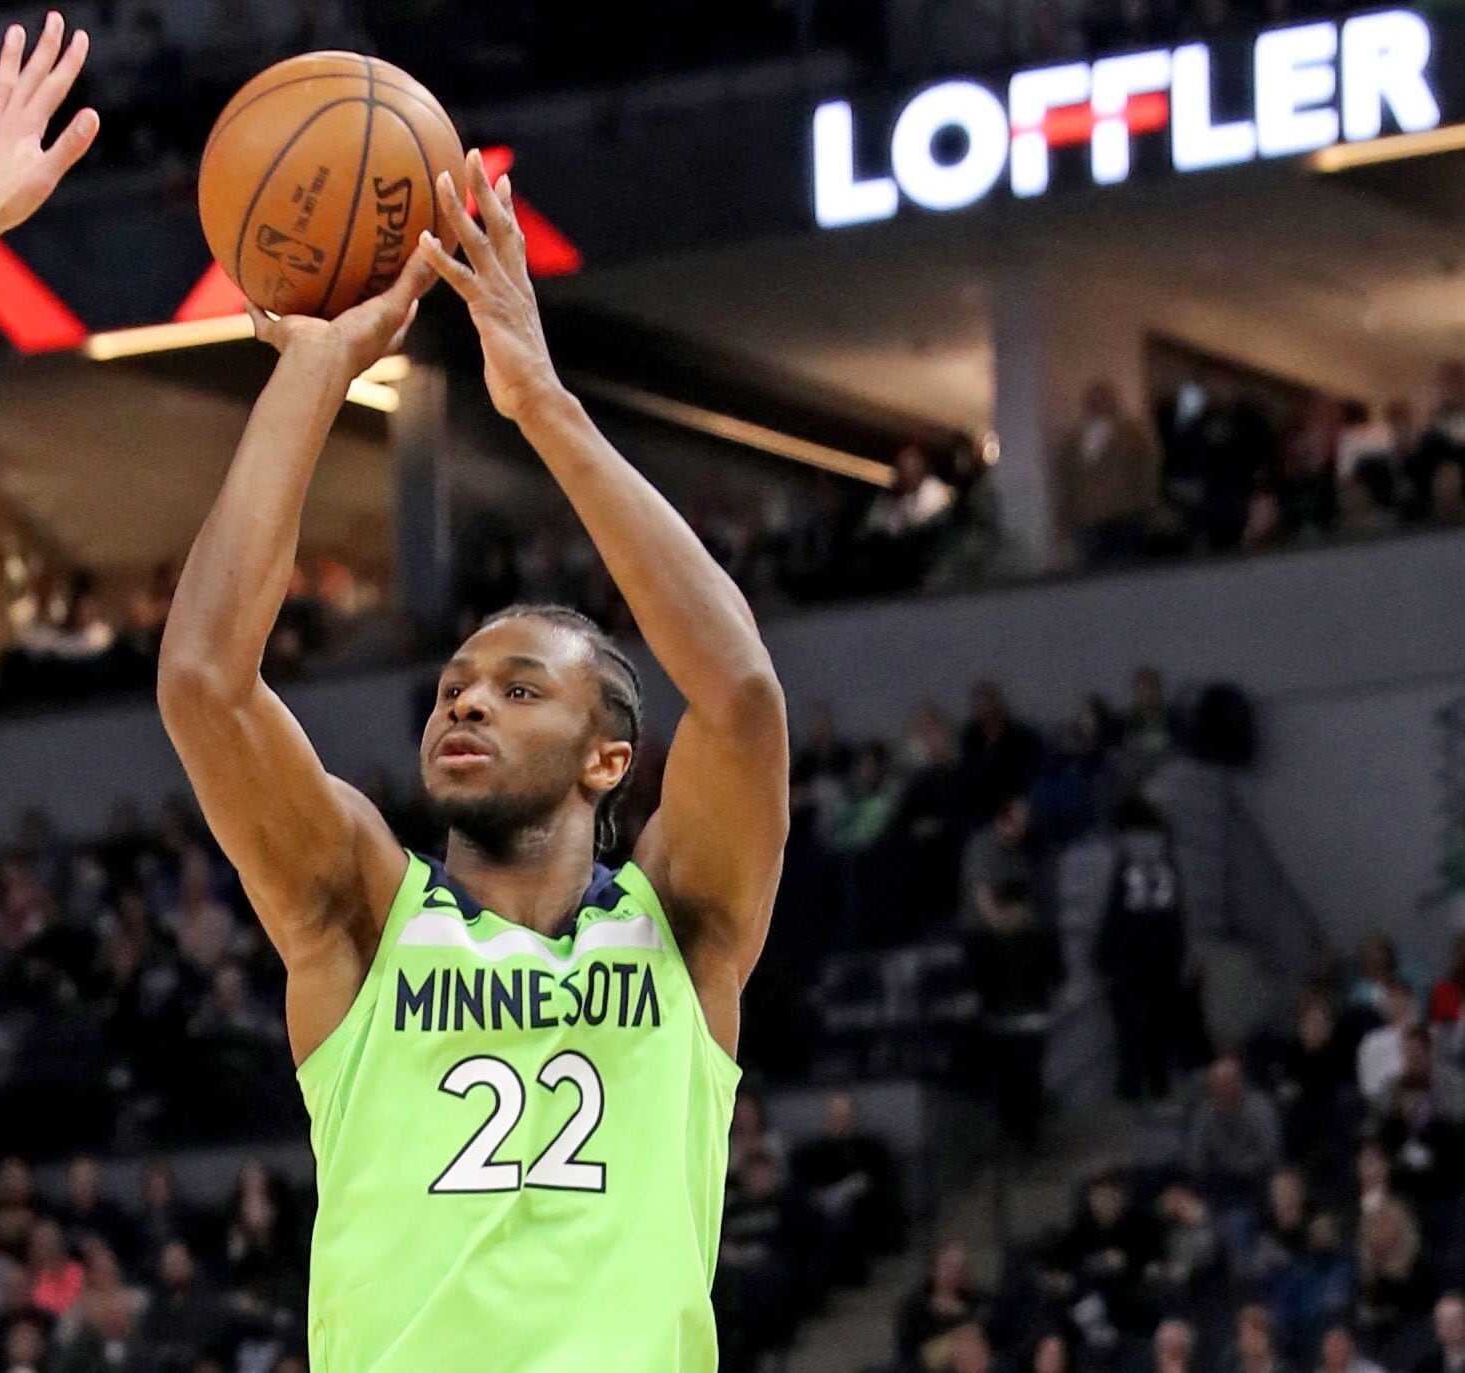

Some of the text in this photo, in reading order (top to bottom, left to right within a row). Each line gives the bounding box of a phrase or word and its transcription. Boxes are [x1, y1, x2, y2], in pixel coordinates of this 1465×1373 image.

[813, 9, 1440, 229] LOFFLER
[394, 961, 661, 1032] MINNESOTA
[428, 1049, 607, 1195] 22
